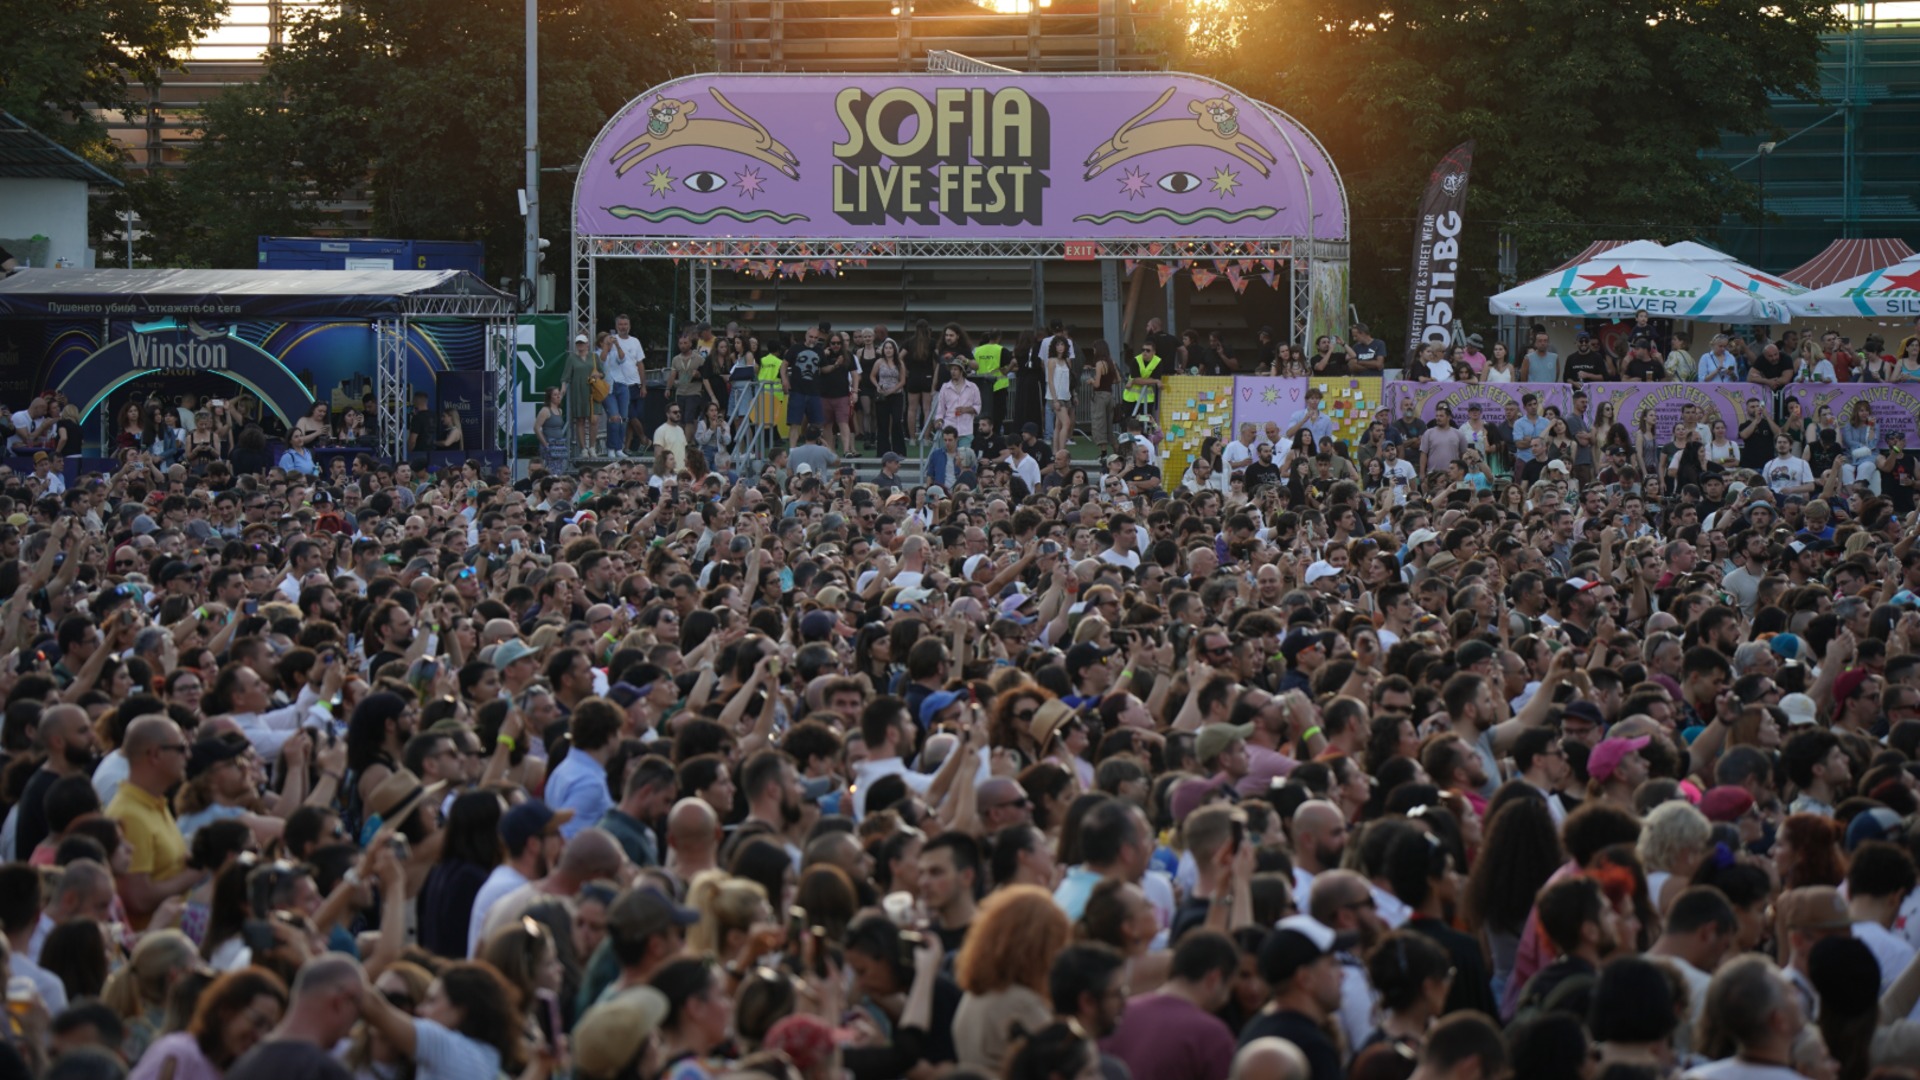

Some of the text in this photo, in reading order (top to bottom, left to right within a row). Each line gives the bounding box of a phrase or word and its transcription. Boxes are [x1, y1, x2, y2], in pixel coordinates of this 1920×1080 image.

[833, 87, 1050, 161] SOFIA
[833, 165, 1034, 216] LIVE FEST
[1421, 214, 1436, 241] WEAR
[1066, 246, 1093, 256] EXIT
[1418, 244, 1432, 278] STREET
[1417, 279, 1428, 287] &
[1547, 285, 1698, 298] Heineken
[1414, 288, 1427, 307] ART
[1596, 296, 1678, 313] SILVER
[1886, 299, 1920, 313] SIL
[48, 302, 102, 314] Пушенето
[105, 303, 137, 315] убива
[148, 305, 200, 313] откажете
[202, 305, 215, 313] се
[218, 305, 241, 315] сега
[127, 331, 228, 369] Winston
[1460, 385, 1485, 401] LIVE
[1487, 386, 1512, 406] FEST
[1657, 384, 1683, 402] LIVE
[1860, 386, 1889, 404] LIVE
